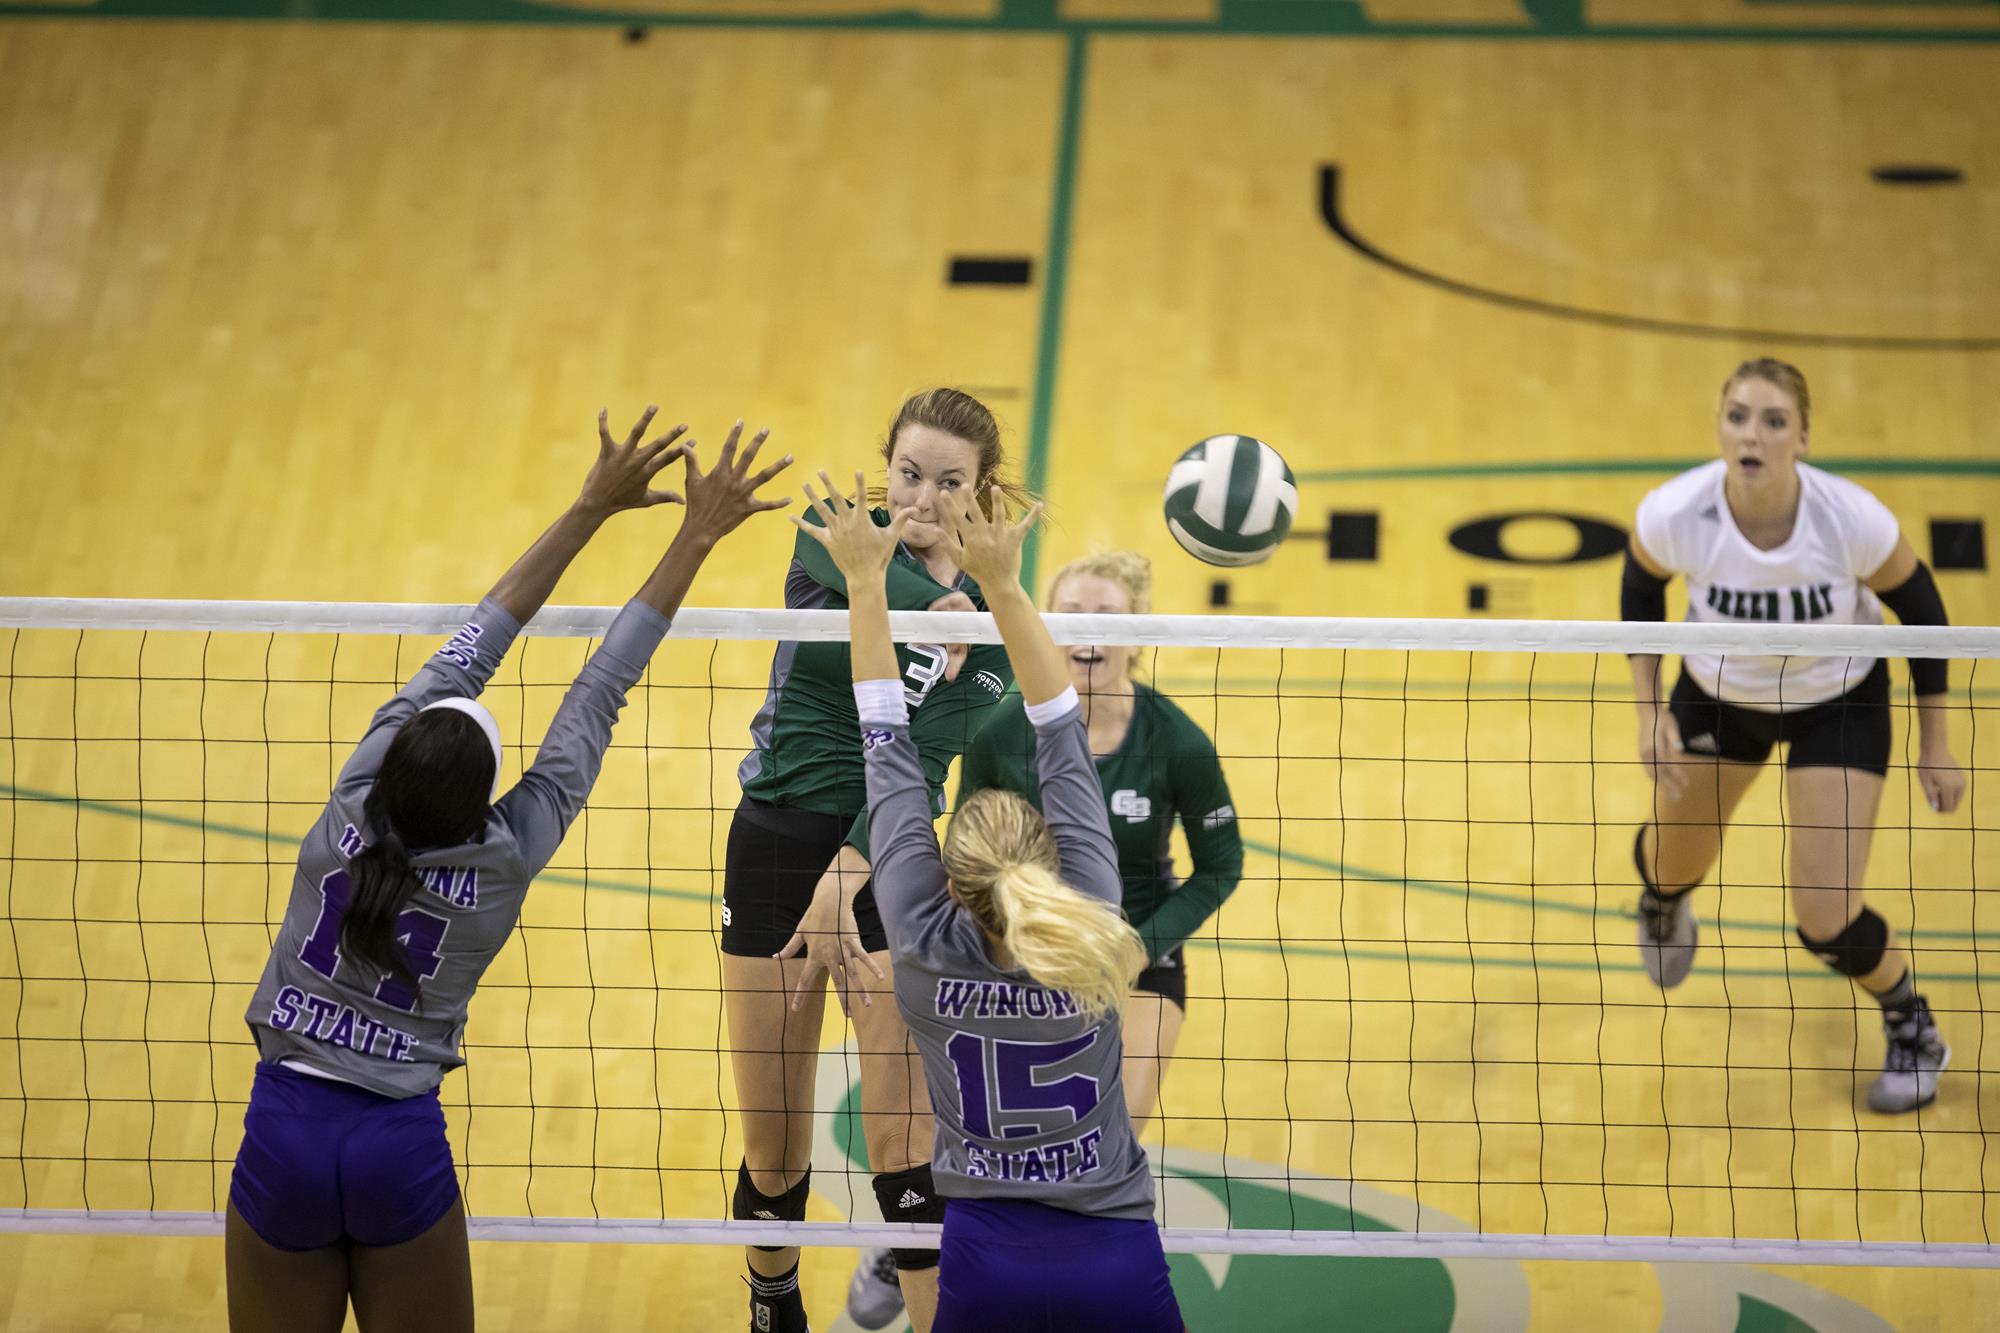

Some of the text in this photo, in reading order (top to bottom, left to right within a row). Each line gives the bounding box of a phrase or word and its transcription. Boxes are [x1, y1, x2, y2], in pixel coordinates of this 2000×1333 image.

[1707, 583, 1834, 621] GREEN BAY
[976, 673, 1002, 693] HORIZON
[338, 823, 479, 910] WNA
[269, 984, 420, 1063] STATE
[935, 977, 1106, 1020] WINON
[945, 1026, 1100, 1140] 15
[962, 1125, 1102, 1184] STATE
[898, 1196, 926, 1208] adidas
